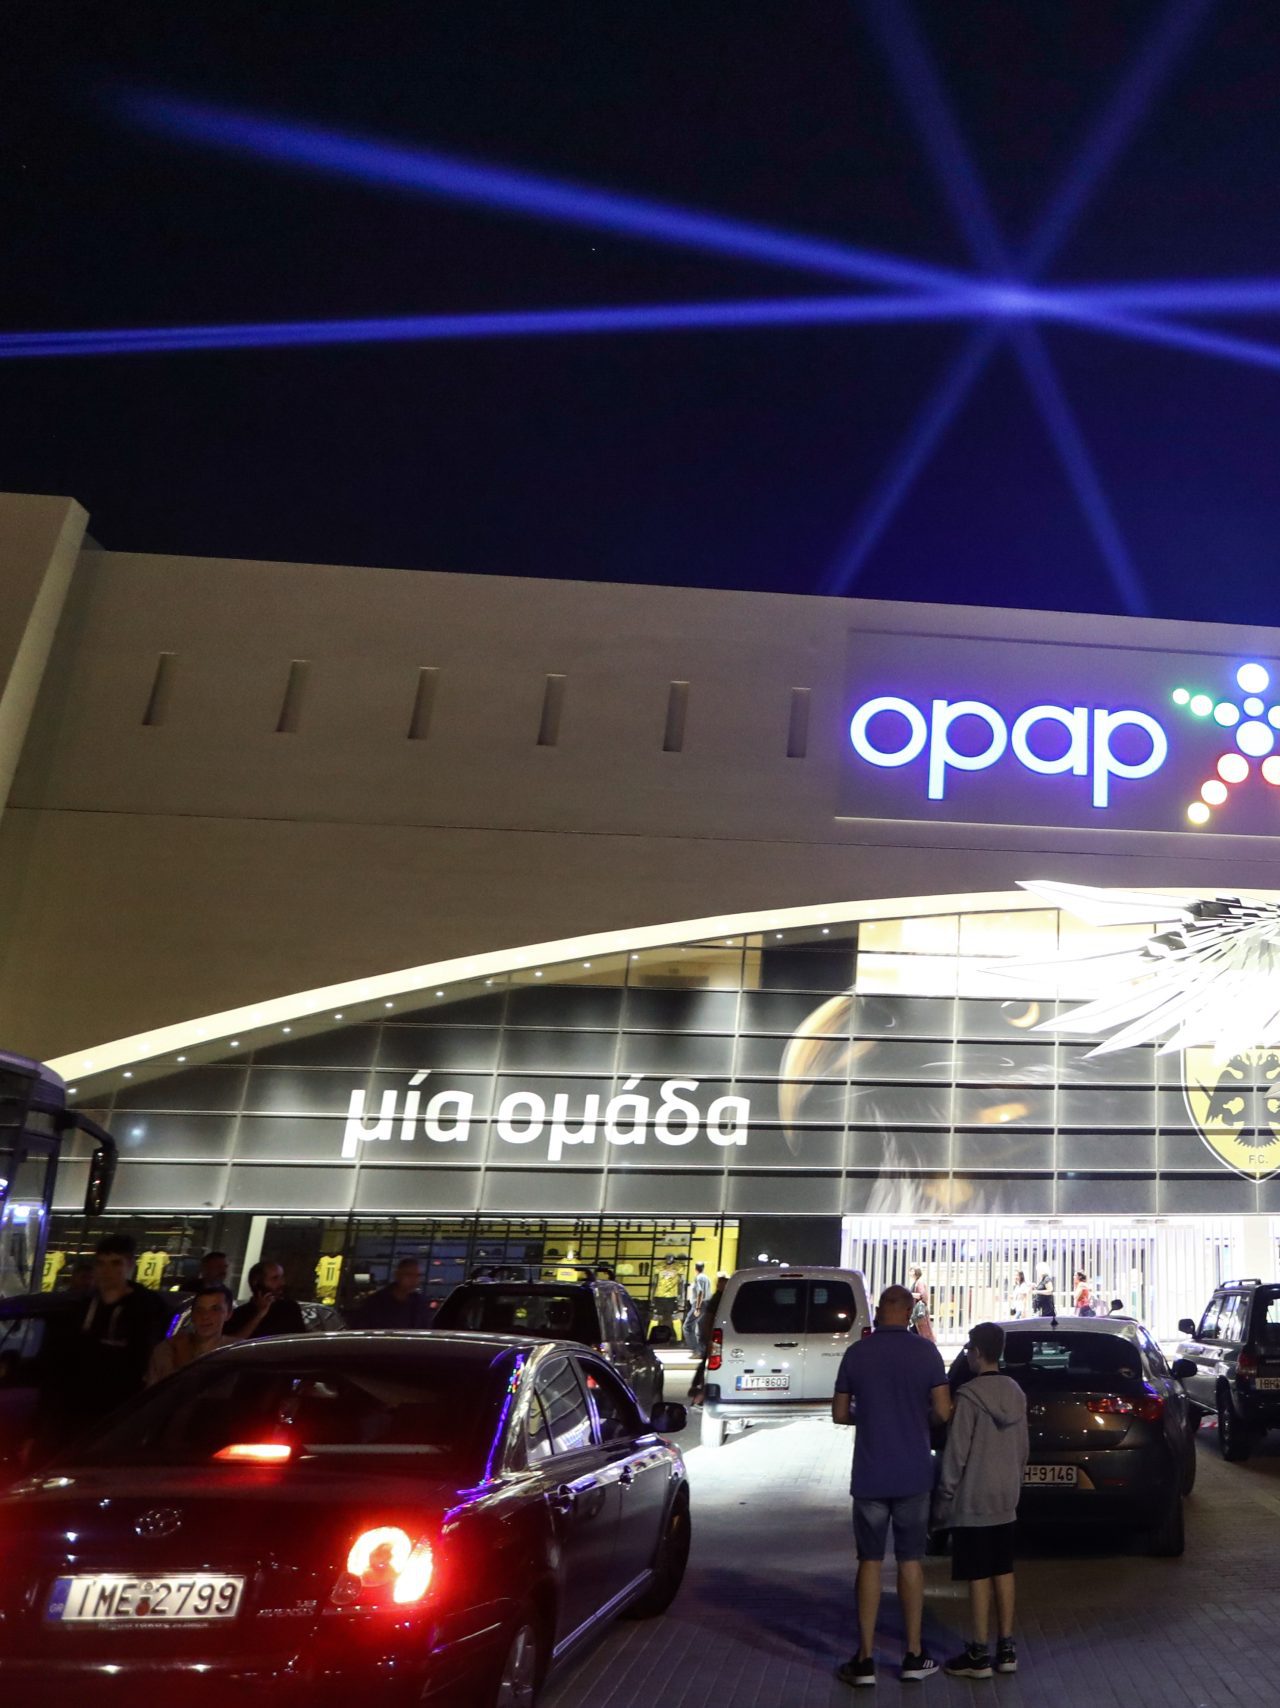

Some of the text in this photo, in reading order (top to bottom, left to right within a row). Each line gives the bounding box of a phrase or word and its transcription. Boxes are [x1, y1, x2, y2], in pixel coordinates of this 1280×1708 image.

[850, 696, 1168, 808] opap
[341, 1069, 752, 1162] μία ομάδα
